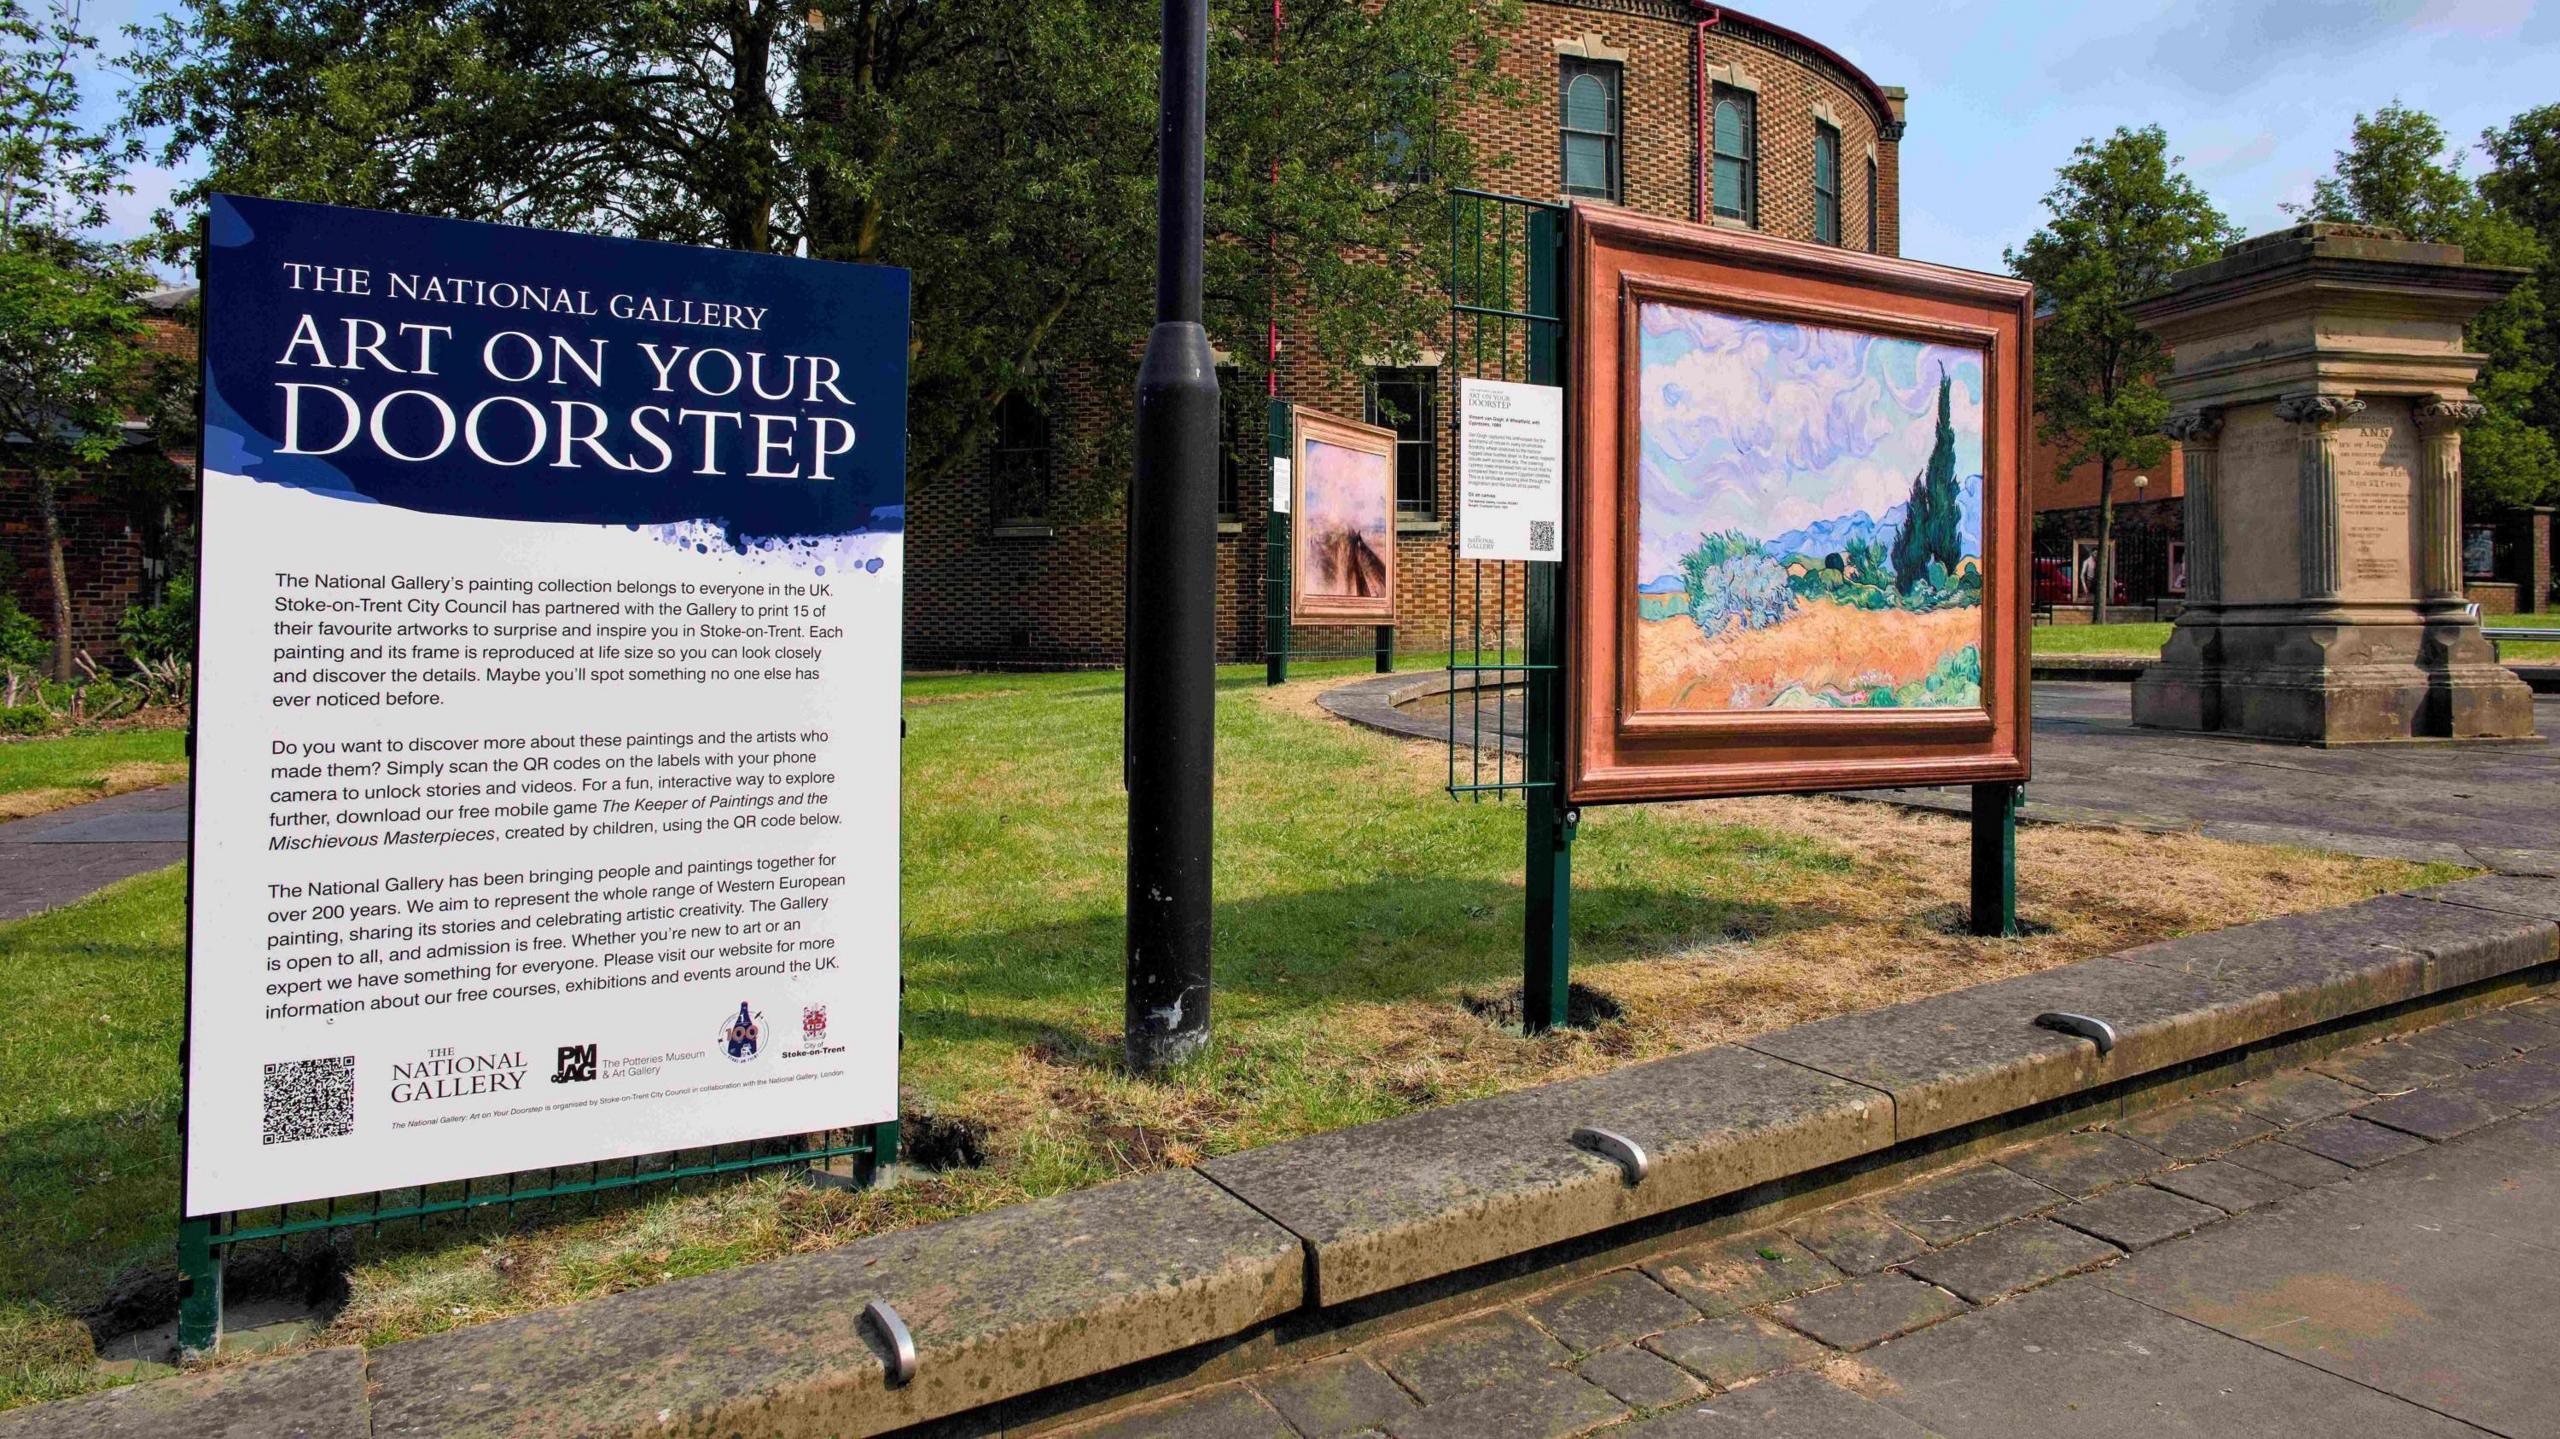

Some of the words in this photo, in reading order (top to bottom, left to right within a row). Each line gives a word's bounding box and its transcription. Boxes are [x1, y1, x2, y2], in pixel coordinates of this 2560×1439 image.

[283, 261, 371, 296] THE
[387, 272, 597, 318] NATIONAL
[610, 294, 768, 331] GALLERY
[275, 313, 453, 375] ART
[483, 331, 608, 388] ON
[637, 343, 856, 405] YOUR
[1469, 399, 1511, 408] DOORSTEP
[274, 381, 856, 481] DOORSTEP
[2360, 428, 2389, 437] ANN
[275, 573, 309, 588] The
[315, 574, 385, 589] National
[391, 575, 463, 593] Gallery's
[469, 578, 533, 595] painting
[538, 579, 611, 592] collection
[617, 580, 676, 597] belongs
[681, 583, 695, 594] to
[700, 585, 764, 598] everyone
[769, 586, 780, 595] in
[784, 584, 805, 596] the
[810, 584, 833, 596] UK.
[275, 597, 402, 612] Stoke-on-Trent
[408, 599, 440, 616] City
[445, 599, 506, 614] Council
[512, 600, 540, 614] has
[545, 602, 619, 617] partnered
[624, 602, 654, 615] with
[659, 603, 682, 615] the
[686, 603, 737, 619] Gallery
[741, 605, 754, 616] to
[759, 606, 788, 619] print
[794, 605, 809, 617] 15
[813, 605, 826, 617] of
[274, 621, 313, 635] their
[318, 621, 392, 636] favourite
[397, 622, 468, 636] artworks
[473, 624, 489, 636] to
[494, 623, 557, 639] surprise
[562, 624, 591, 637] and
[597, 627, 646, 640] inspire
[651, 627, 678, 640] you
[683, 627, 695, 636] in
[700, 624, 805, 638] Stoke-on-Trent.
[810, 626, 843, 638] Each
[273, 696, 311, 707] ever
[316, 692, 380, 706] noticed
[386, 691, 443, 705] before.
[272, 740, 297, 755] Do
[303, 743, 335, 758] you
[341, 739, 382, 753] want
[387, 739, 403, 752] to
[409, 738, 479, 751] discover
[484, 738, 526, 749] more
[530, 735, 575, 748] about
[580, 734, 622, 747] these
[627, 734, 693, 749] paintings
[698, 732, 725, 744] and
[730, 731, 752, 743] the
[757, 731, 796, 743] artists
[800, 730, 828, 742] who
[270, 812, 330, 827] further,
[336, 807, 420, 824] download
[426, 809, 454, 820] our
[458, 805, 489, 818] free
[495, 802, 549, 817] mobile
[553, 803, 597, 818] game
[603, 799, 630, 812] The
[634, 798, 688, 813] Keeper
[692, 796, 706, 809] of
[710, 795, 774, 809] Paintings
[778, 793, 804, 805] and
[807, 792, 828, 804] the
[268, 884, 302, 898] The
[308, 879, 379, 896] National
[385, 877, 444, 892] Gallery
[449, 875, 478, 888] has
[484, 873, 524, 886] been
[529, 870, 593, 885] bringing
[599, 864, 650, 882] people
[655, 862, 683, 876] and
[688, 860, 752, 876] paintings
[757, 856, 815, 872] together
[819, 854, 836, 866] for
[266, 999, 365, 1019] information
[370, 993, 420, 1010] about
[425, 993, 452, 1005] our
[457, 988, 488, 1002] free
[493, 984, 560, 999] courses,
[566, 976, 646, 992] exhibitions
[651, 970, 679, 985] and
[684, 967, 731, 982] events
[736, 961, 785, 977] around
[790, 960, 811, 972] the
[816, 957, 840, 970] UK.
[726, 1025, 758, 1041] 100
[428, 1047, 454, 1058] THE
[558, 1044, 597, 1071] PM
[782, 1046, 845, 1059] Stoke-on-Trent
[804, 1042, 817, 1050] City
[392, 1052, 528, 1080] NATIONAL
[602, 1070, 609, 1079] &
[612, 1069, 625, 1077] Art
[628, 1064, 661, 1076] Gallery
[603, 1059, 620, 1068] The
[622, 1054, 663, 1066] Potteries
[665, 1050, 705, 1062] Museum
[391, 1070, 527, 1103] GALLERY
[408, 1118, 438, 1128] National
[493, 1109, 508, 1117] Your
[510, 1106, 543, 1116] Doorstep
[553, 1101, 588, 1112] organised
[589, 1099, 598, 1107] by
[600, 1092, 649, 1104] Stoke-on-Trent
[650, 1090, 663, 1099] City
[665, 1088, 690, 1097] Council
[700, 1082, 740, 1092] collaboration
[769, 1076, 794, 1084] National
[821, 1070, 844, 1078] London
